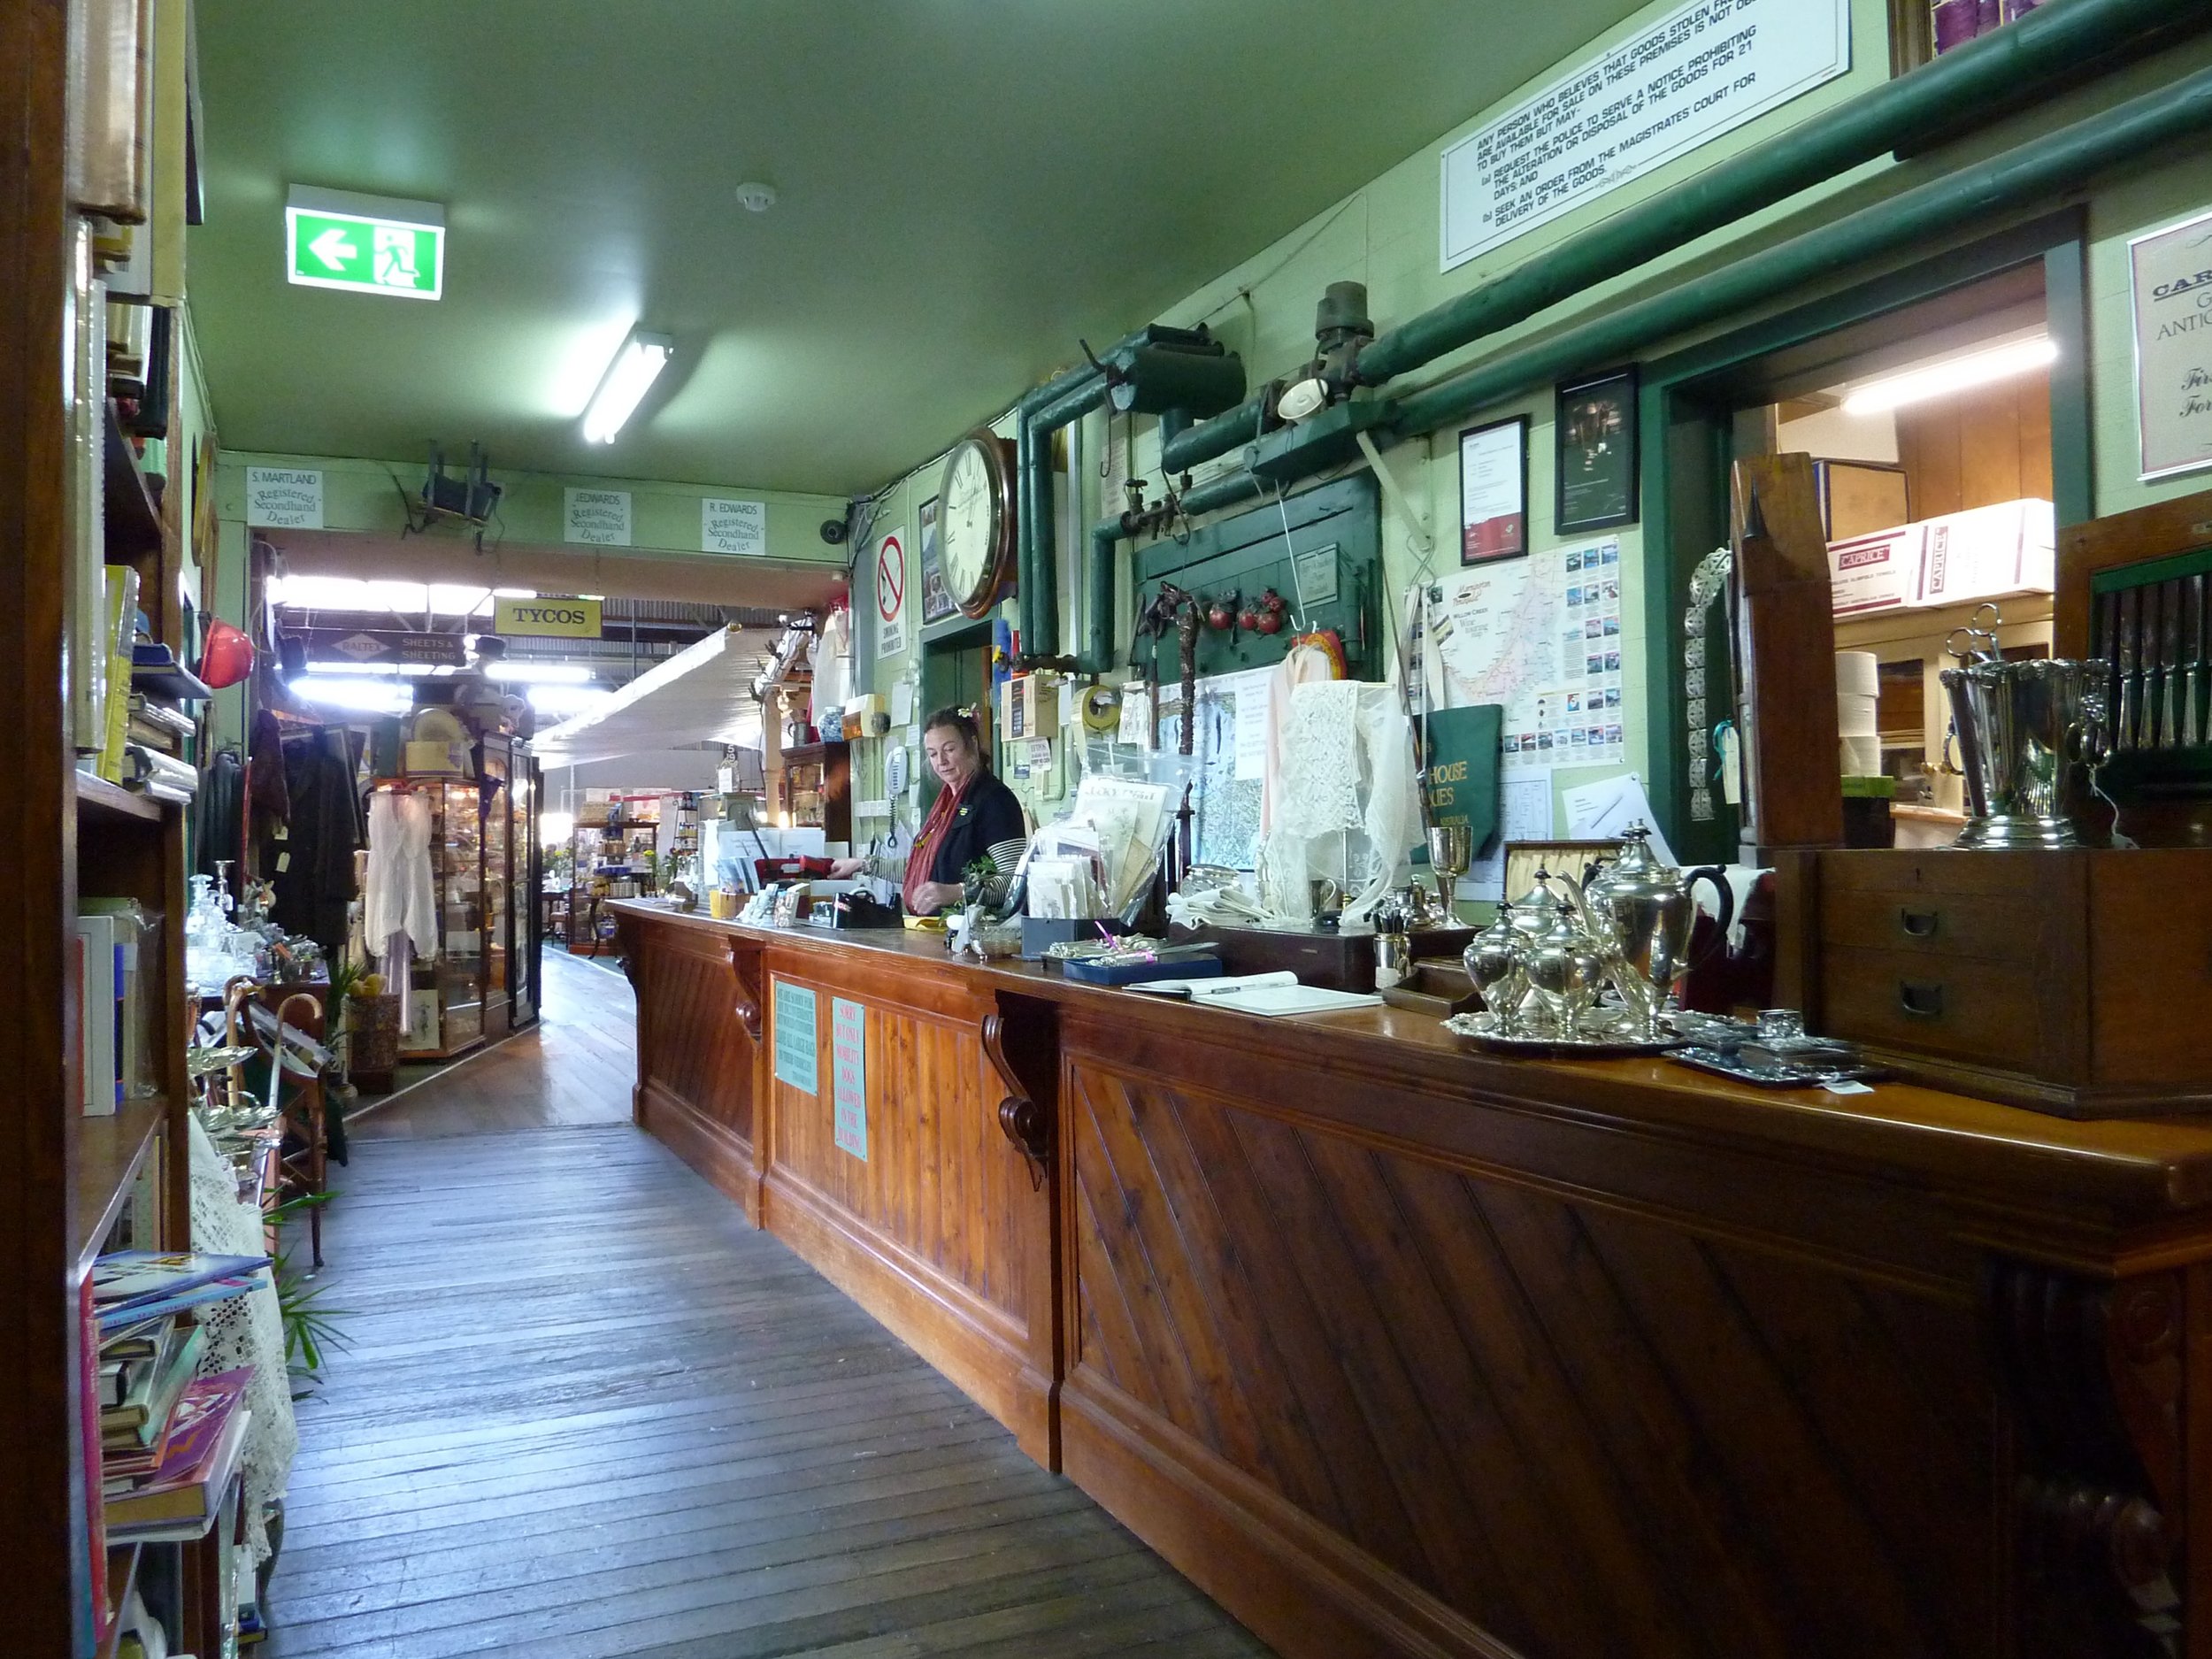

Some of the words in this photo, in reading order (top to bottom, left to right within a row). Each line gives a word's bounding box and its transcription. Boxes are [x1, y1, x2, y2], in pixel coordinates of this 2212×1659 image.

[1478, 134, 1495, 150] ANY
[1497, 111, 1531, 138] PERSON
[1533, 97, 1555, 117] WHO
[1558, 71, 1600, 103] BELIEVES
[1603, 54, 1628, 76] THAT
[1631, 32, 1665, 59] GOODS
[1670, 5, 1709, 37] STOLEN
[1478, 147, 1493, 162] ARE
[1495, 119, 1540, 154] AVAILABLE
[1541, 107, 1559, 124] FOR
[1563, 92, 1585, 111] SALE
[1589, 82, 1602, 96] ON
[1606, 60, 1635, 86] THESE
[1639, 29, 1690, 67] PREMISES
[1695, 21, 1705, 34] IS
[1709, 4, 1732, 27] NOT
[1494, 151, 1531, 179] REQUEST
[1533, 141, 1550, 157] THE
[1553, 122, 1583, 145] POLICE
[1587, 113, 1598, 127] TO
[1601, 94, 1632, 119] SERVE
[1637, 88, 1644, 101] A
[1647, 65, 1685, 94] NOTICE
[1688, 25, 1756, 70] PROHIBITING
[1494, 173, 1510, 189] THE
[1513, 145, 1563, 179] ALTERATION
[1566, 136, 1578, 150] OR
[1582, 111, 1628, 142] DISPOSAL
[1632, 101, 1645, 115] OF
[1648, 88, 1667, 105] THE
[1671, 65, 1708, 93] GOODS
[1713, 50, 1734, 71] FOR
[1739, 40, 1752, 57] 21
[1478, 160, 1487, 172] TO
[1490, 149, 1507, 165] BUY
[1509, 134, 1533, 153] THEM
[1536, 122, 1553, 139] BUT
[1495, 198, 1517, 217] SEEK
[1520, 190, 1532, 204] AN
[1535, 173, 1564, 196] ORDER
[1568, 157, 1594, 180] FROM
[1598, 147, 1616, 163] THE
[1694, 85, 1729, 113] COURT
[1733, 73, 1755, 92] FOR
[1520, 171, 1539, 188] AND
[1495, 202, 1534, 227] DELIVERY
[1538, 193, 1549, 205] OF
[1553, 184, 1570, 198] THE
[252, 472, 260, 482] S.
[262, 472, 317, 485] MARTLAND
[257, 488, 315, 503] Registered
[580, 492, 620, 505] EDWARDS
[255, 499, 316, 511] Secondhand
[720, 503, 757, 515] EDWARDS
[267, 511, 304, 525] Dealer
[572, 509, 623, 522] Registered
[570, 518, 625, 531] Secondhand
[711, 518, 758, 533] Registered
[581, 529, 616, 542] Dealer
[708, 527, 759, 540] Secondhand
[718, 538, 750, 551] Dealer
[1840, 549, 1885, 566] CAPRICE
[1932, 526, 1947, 592] CAPRICE
[513, 608, 586, 625] TYCOS
[883, 623, 899, 639] SMOKING
[402, 637, 444, 649] SHEETS
[881, 637, 901, 655] PROHIBITED
[402, 649, 455, 660] SHEETING
[840, 1005, 855, 1021] SORRY
[842, 1067, 856, 1085] DOGS
[837, 1086, 861, 1109] ALLOWED
